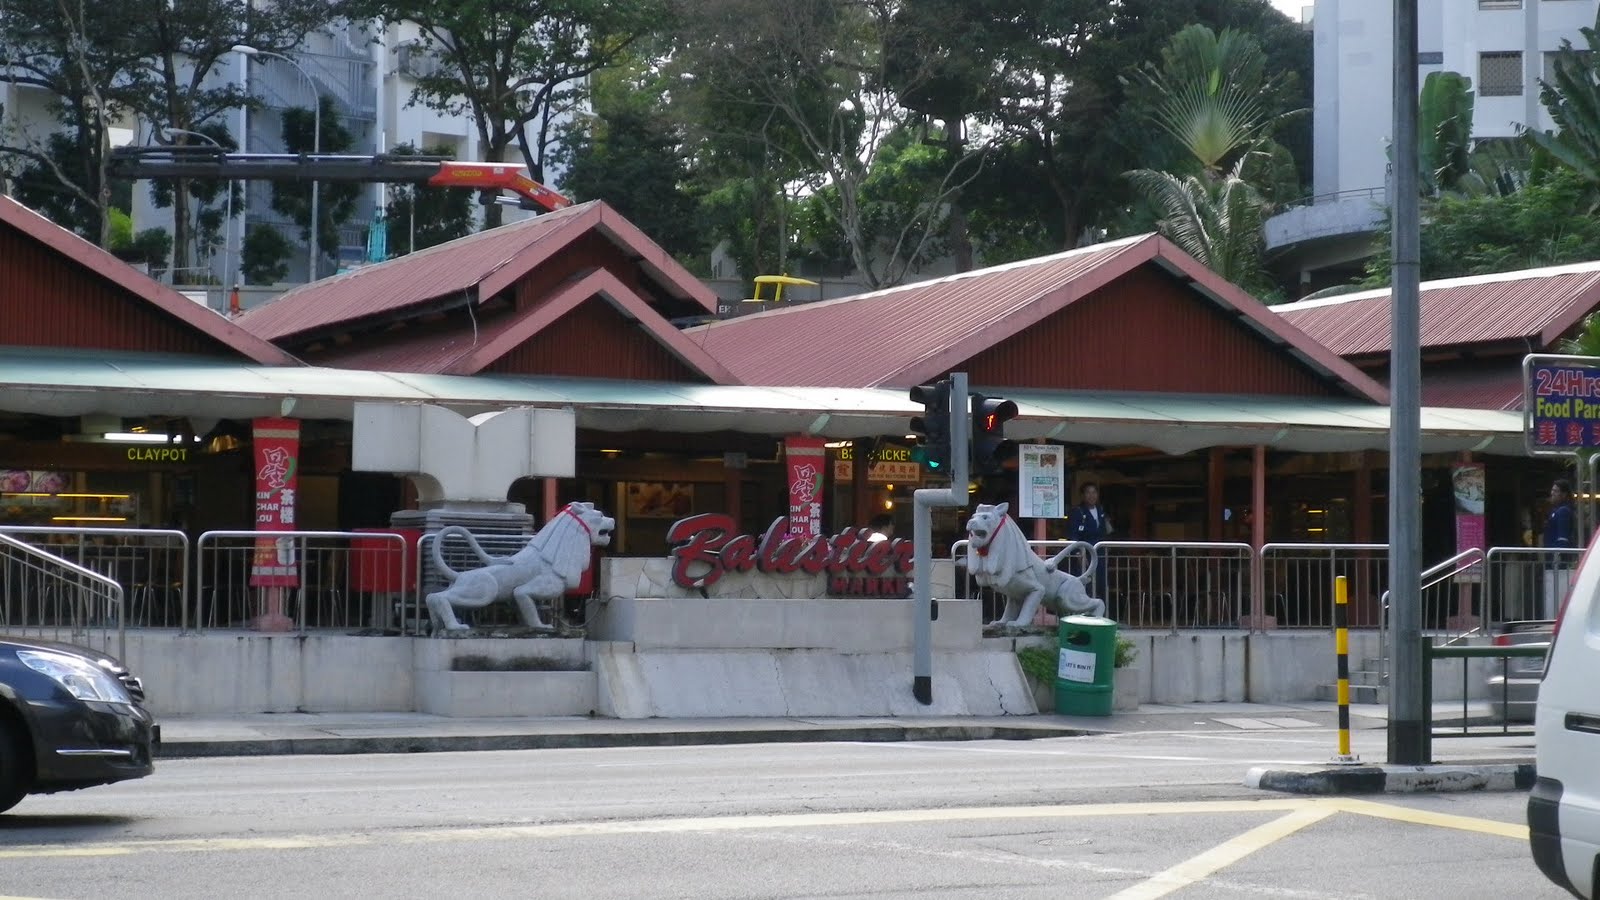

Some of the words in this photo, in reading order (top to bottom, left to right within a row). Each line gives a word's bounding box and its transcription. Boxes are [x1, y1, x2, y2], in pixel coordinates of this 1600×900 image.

[1536, 397, 1571, 418] Food
[1574, 398, 1600, 418] Par
[127, 448, 187, 461] CLAYPOT
[790, 515, 809, 523] HAR
[790, 526, 804, 534] OU
[828, 576, 914, 597] MARKE
